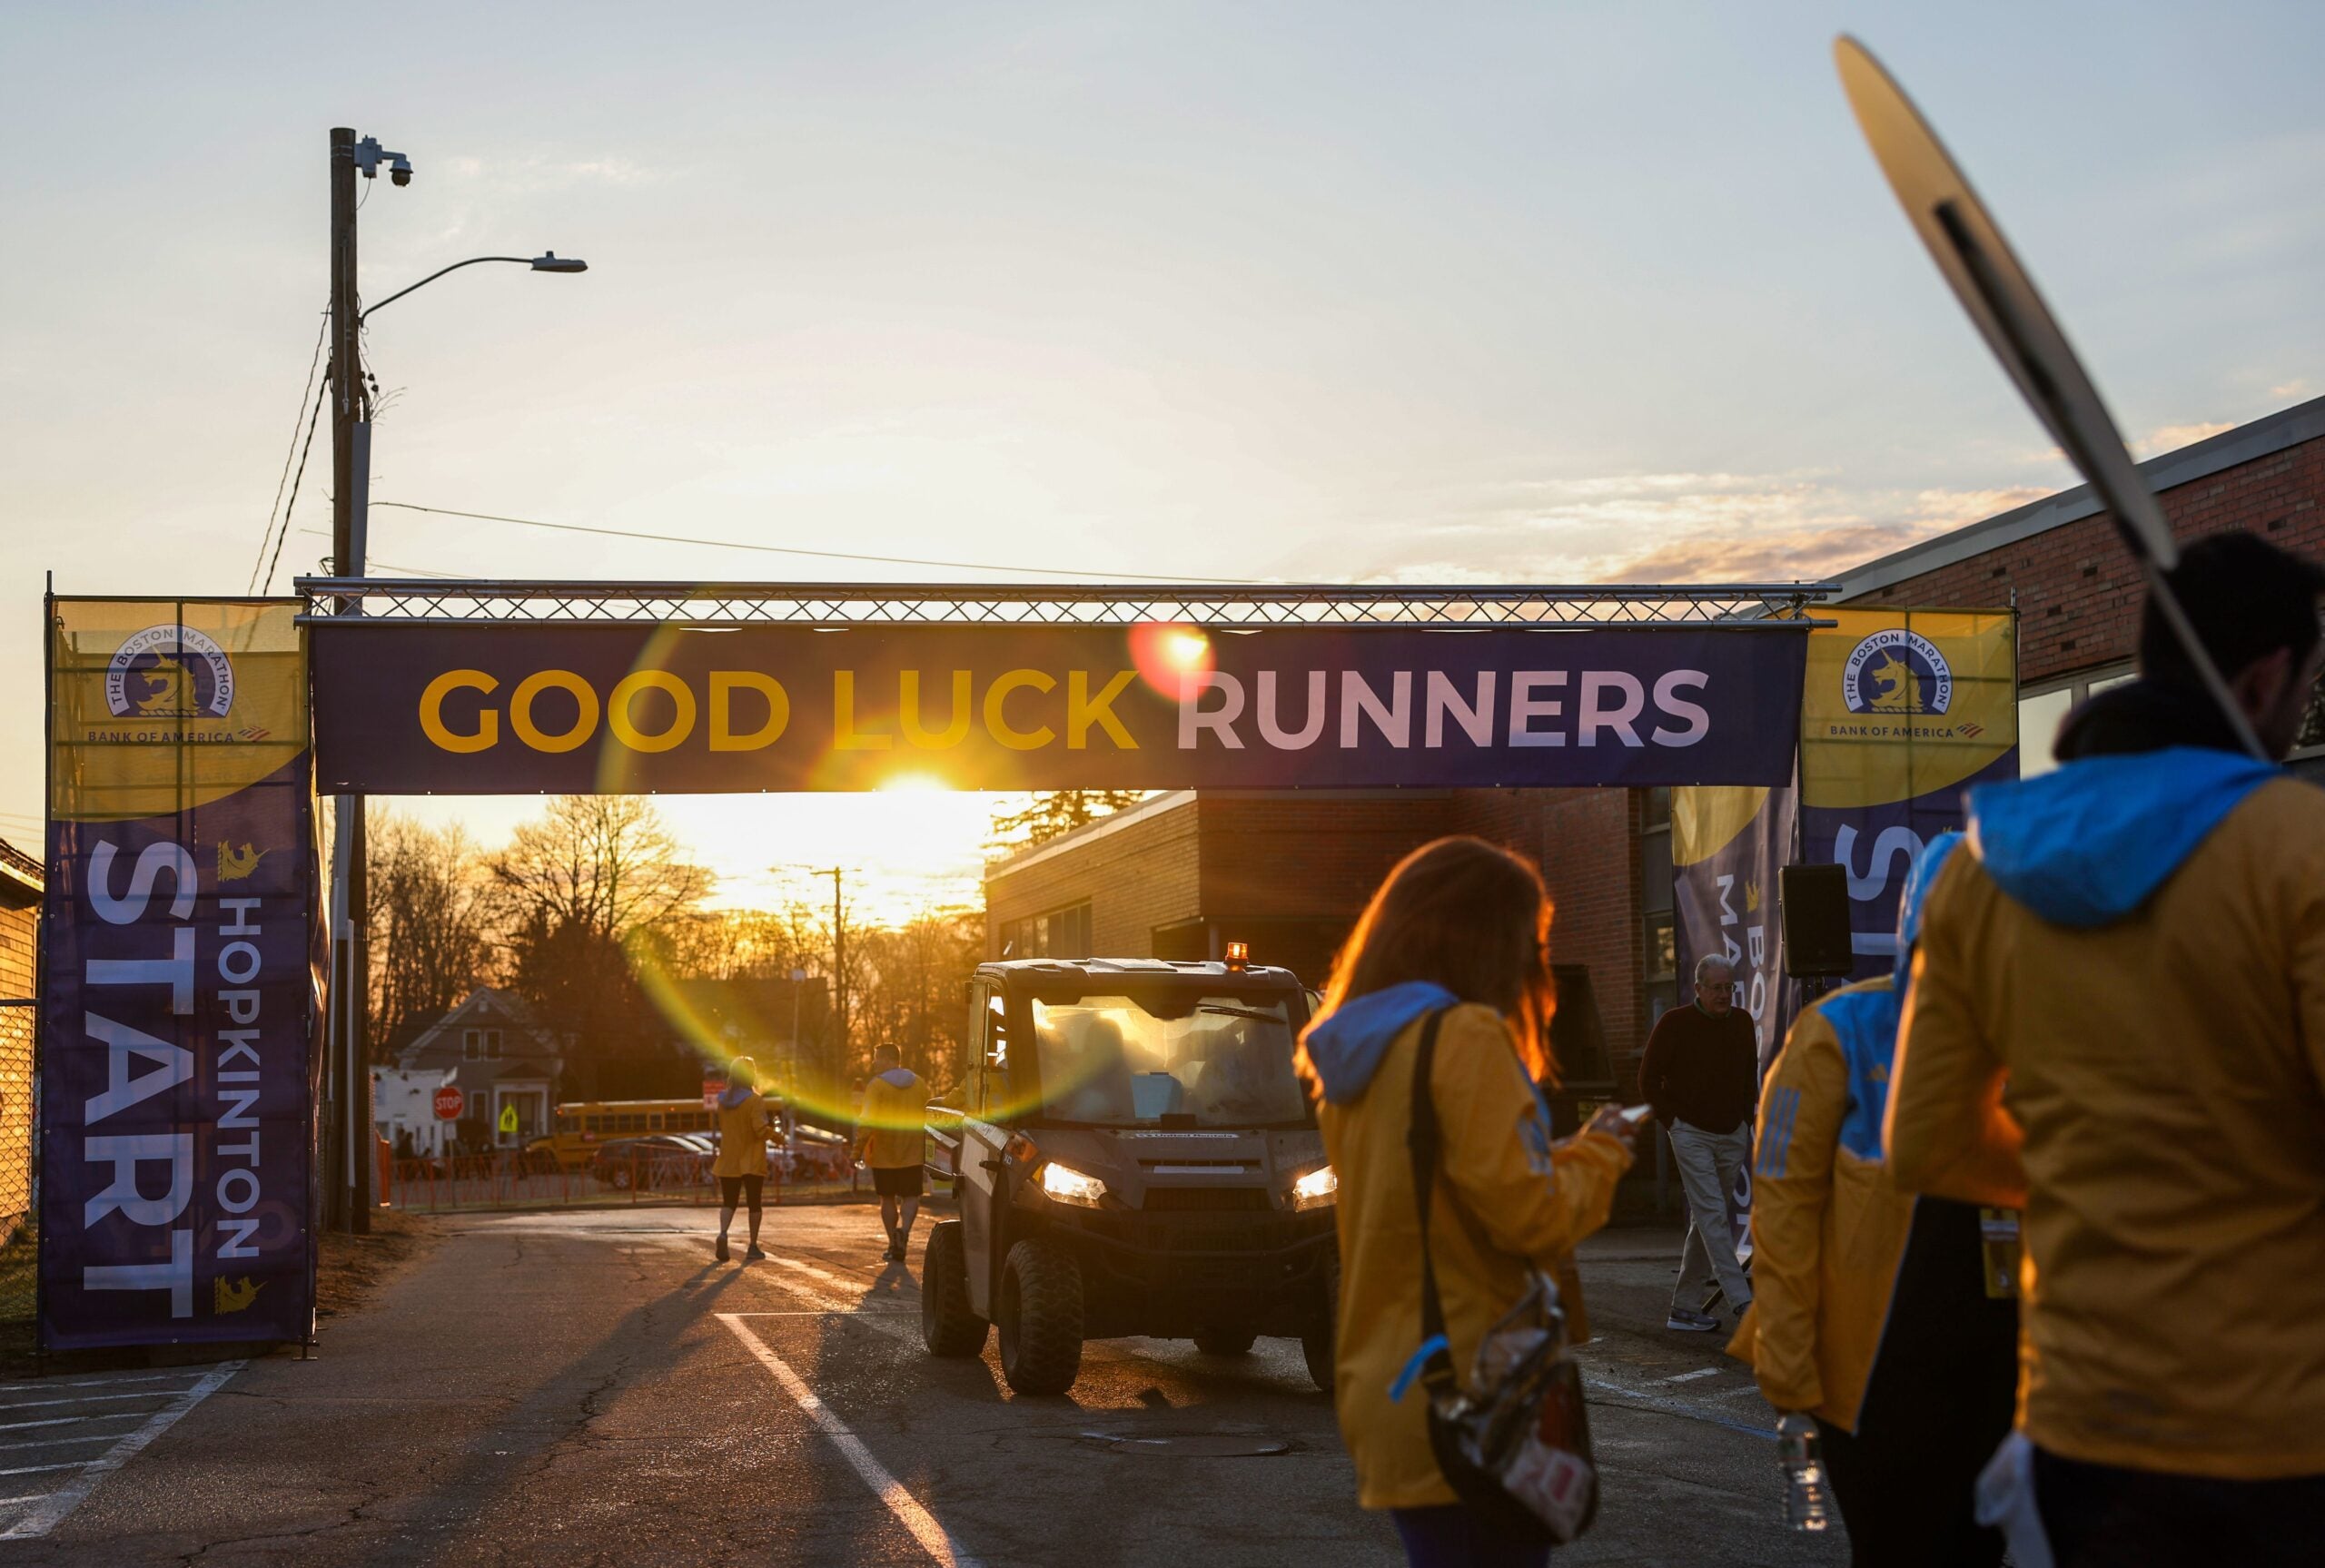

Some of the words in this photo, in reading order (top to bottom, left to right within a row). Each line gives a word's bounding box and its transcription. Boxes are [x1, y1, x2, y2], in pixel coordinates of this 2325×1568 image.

[110, 673, 122, 705] THE
[116, 628, 173, 666] BOSTON
[183, 630, 230, 707] MARATHON
[1851, 633, 1900, 667] BOSTON
[1907, 635, 1950, 706] MARATHON
[419, 668, 789, 754] GOOD
[833, 668, 1140, 751] LUCK
[1177, 668, 1710, 751] RUNNERS
[1846, 673, 1857, 703] THE
[88, 731, 132, 743] BANK
[137, 732, 157, 743] OF
[158, 732, 234, 743] AMERICA
[1830, 725, 1867, 736] BANK
[1871, 726, 1889, 737] OF
[1893, 727, 1954, 738] AMERICA
[84, 839, 198, 1318] START
[215, 898, 262, 1259] HOPKINTON
[435, 1095, 461, 1110] STOP
